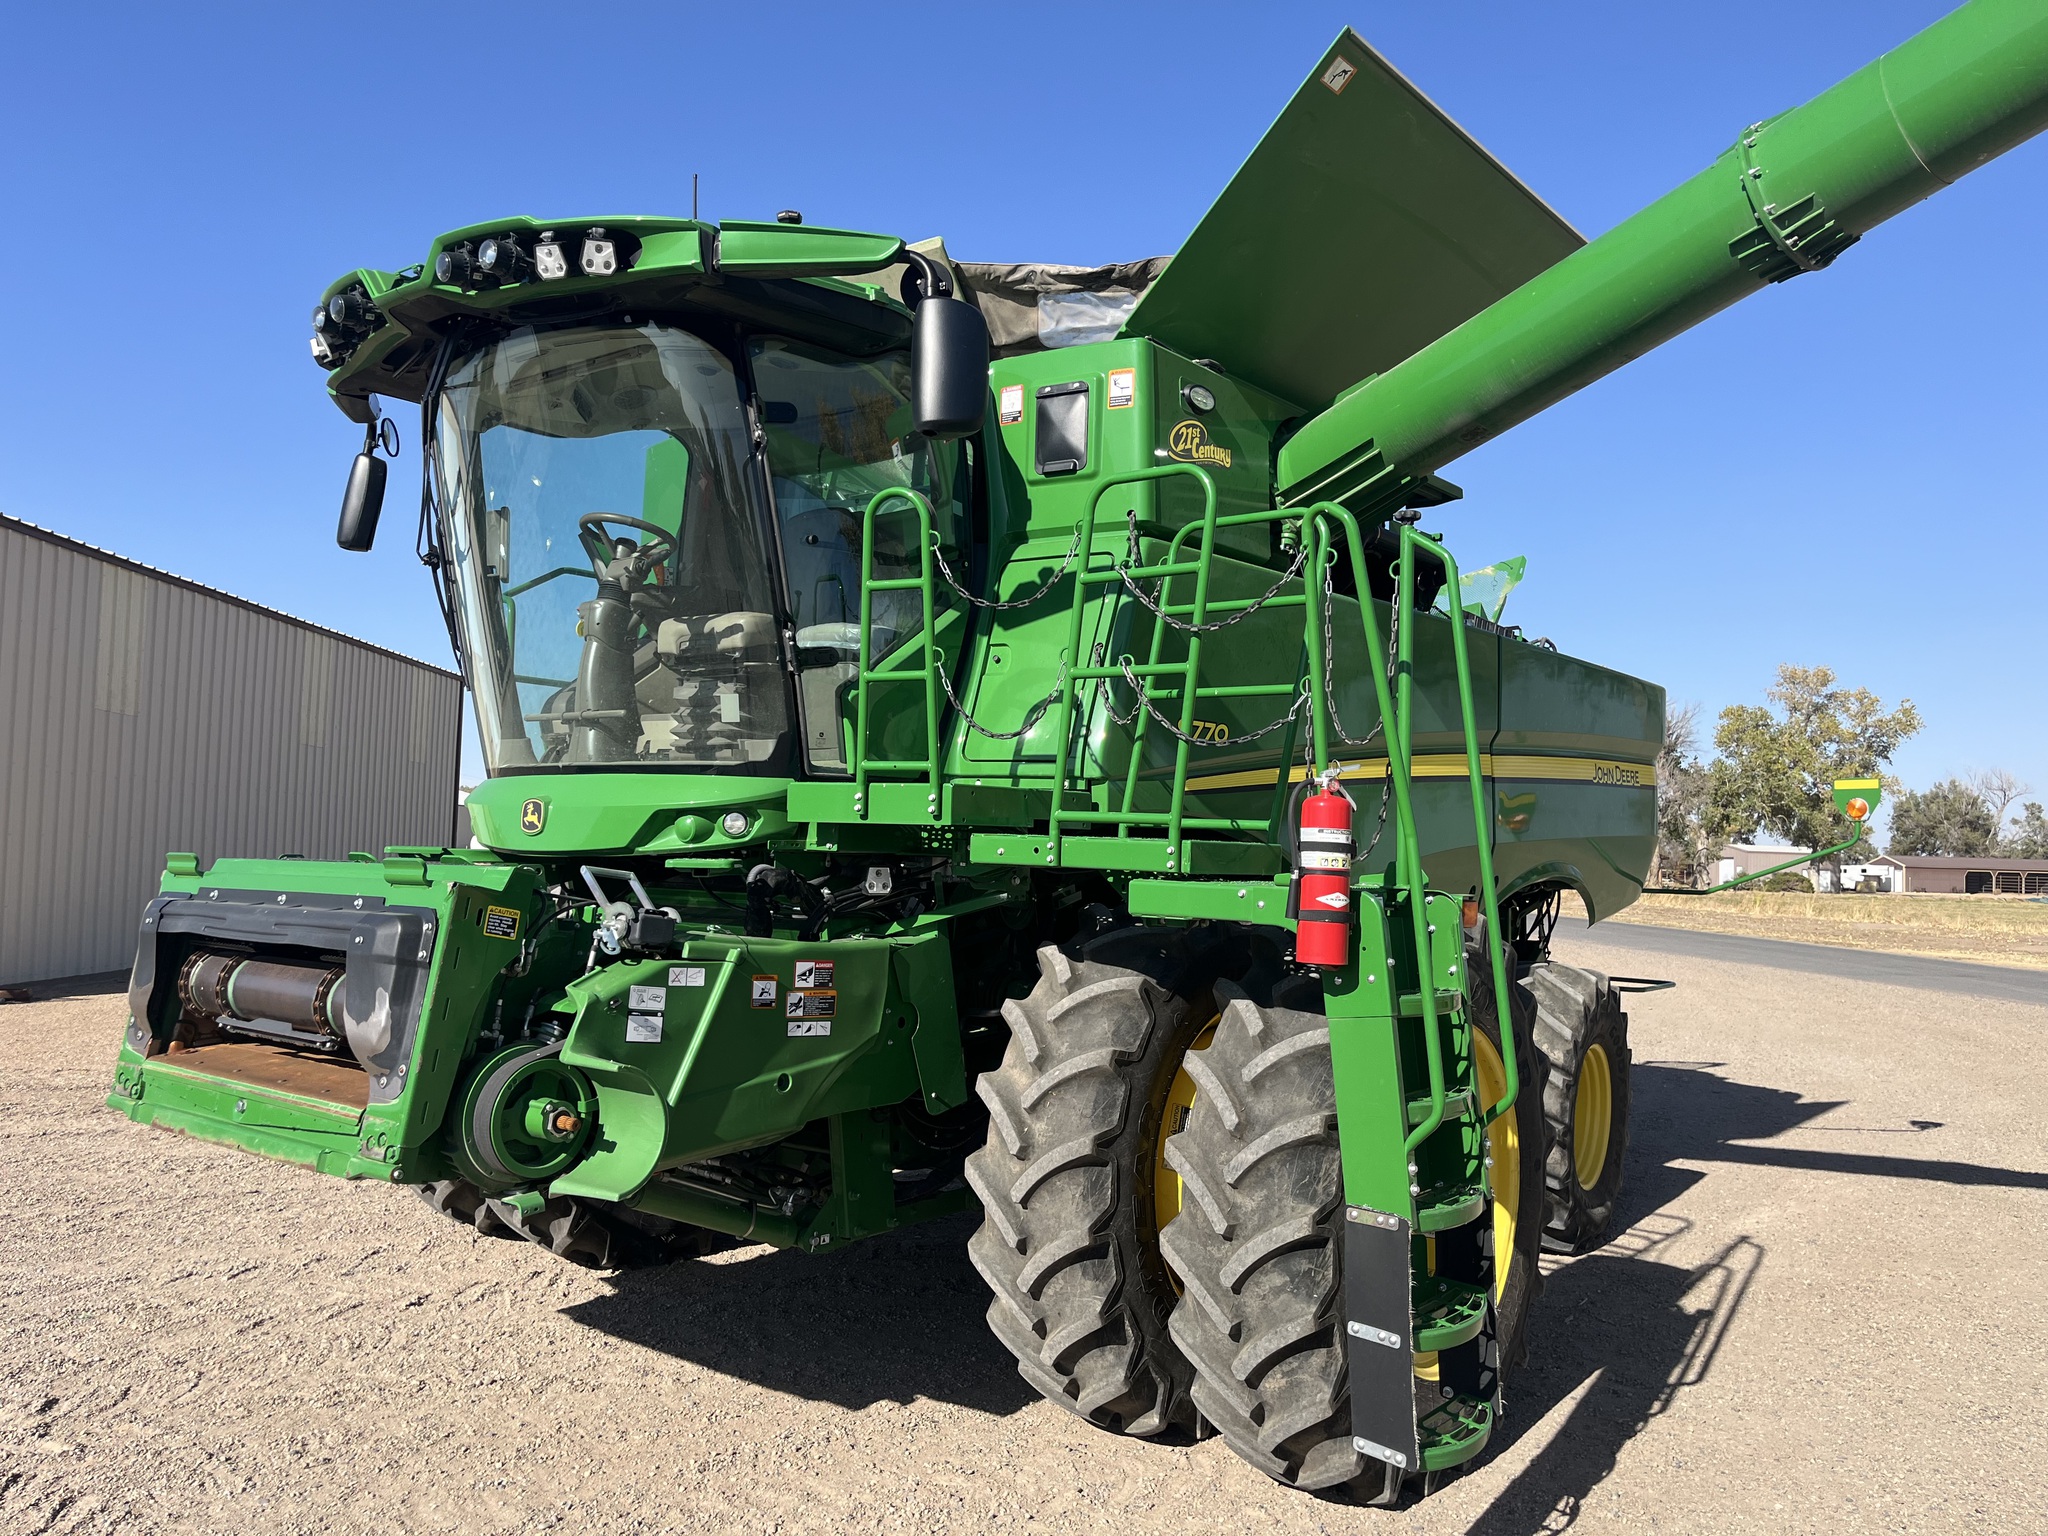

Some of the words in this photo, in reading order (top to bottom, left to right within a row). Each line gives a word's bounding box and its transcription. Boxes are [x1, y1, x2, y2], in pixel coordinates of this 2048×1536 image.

[1176, 427, 1201, 452] 21st
[1178, 719, 1229, 742] 770
[1593, 763, 1614, 783] JOHN
[1615, 765, 1640, 785] DEERE
[494, 908, 519, 917] CAUTION
[1171, 1105, 1180, 1130] CAUTION
